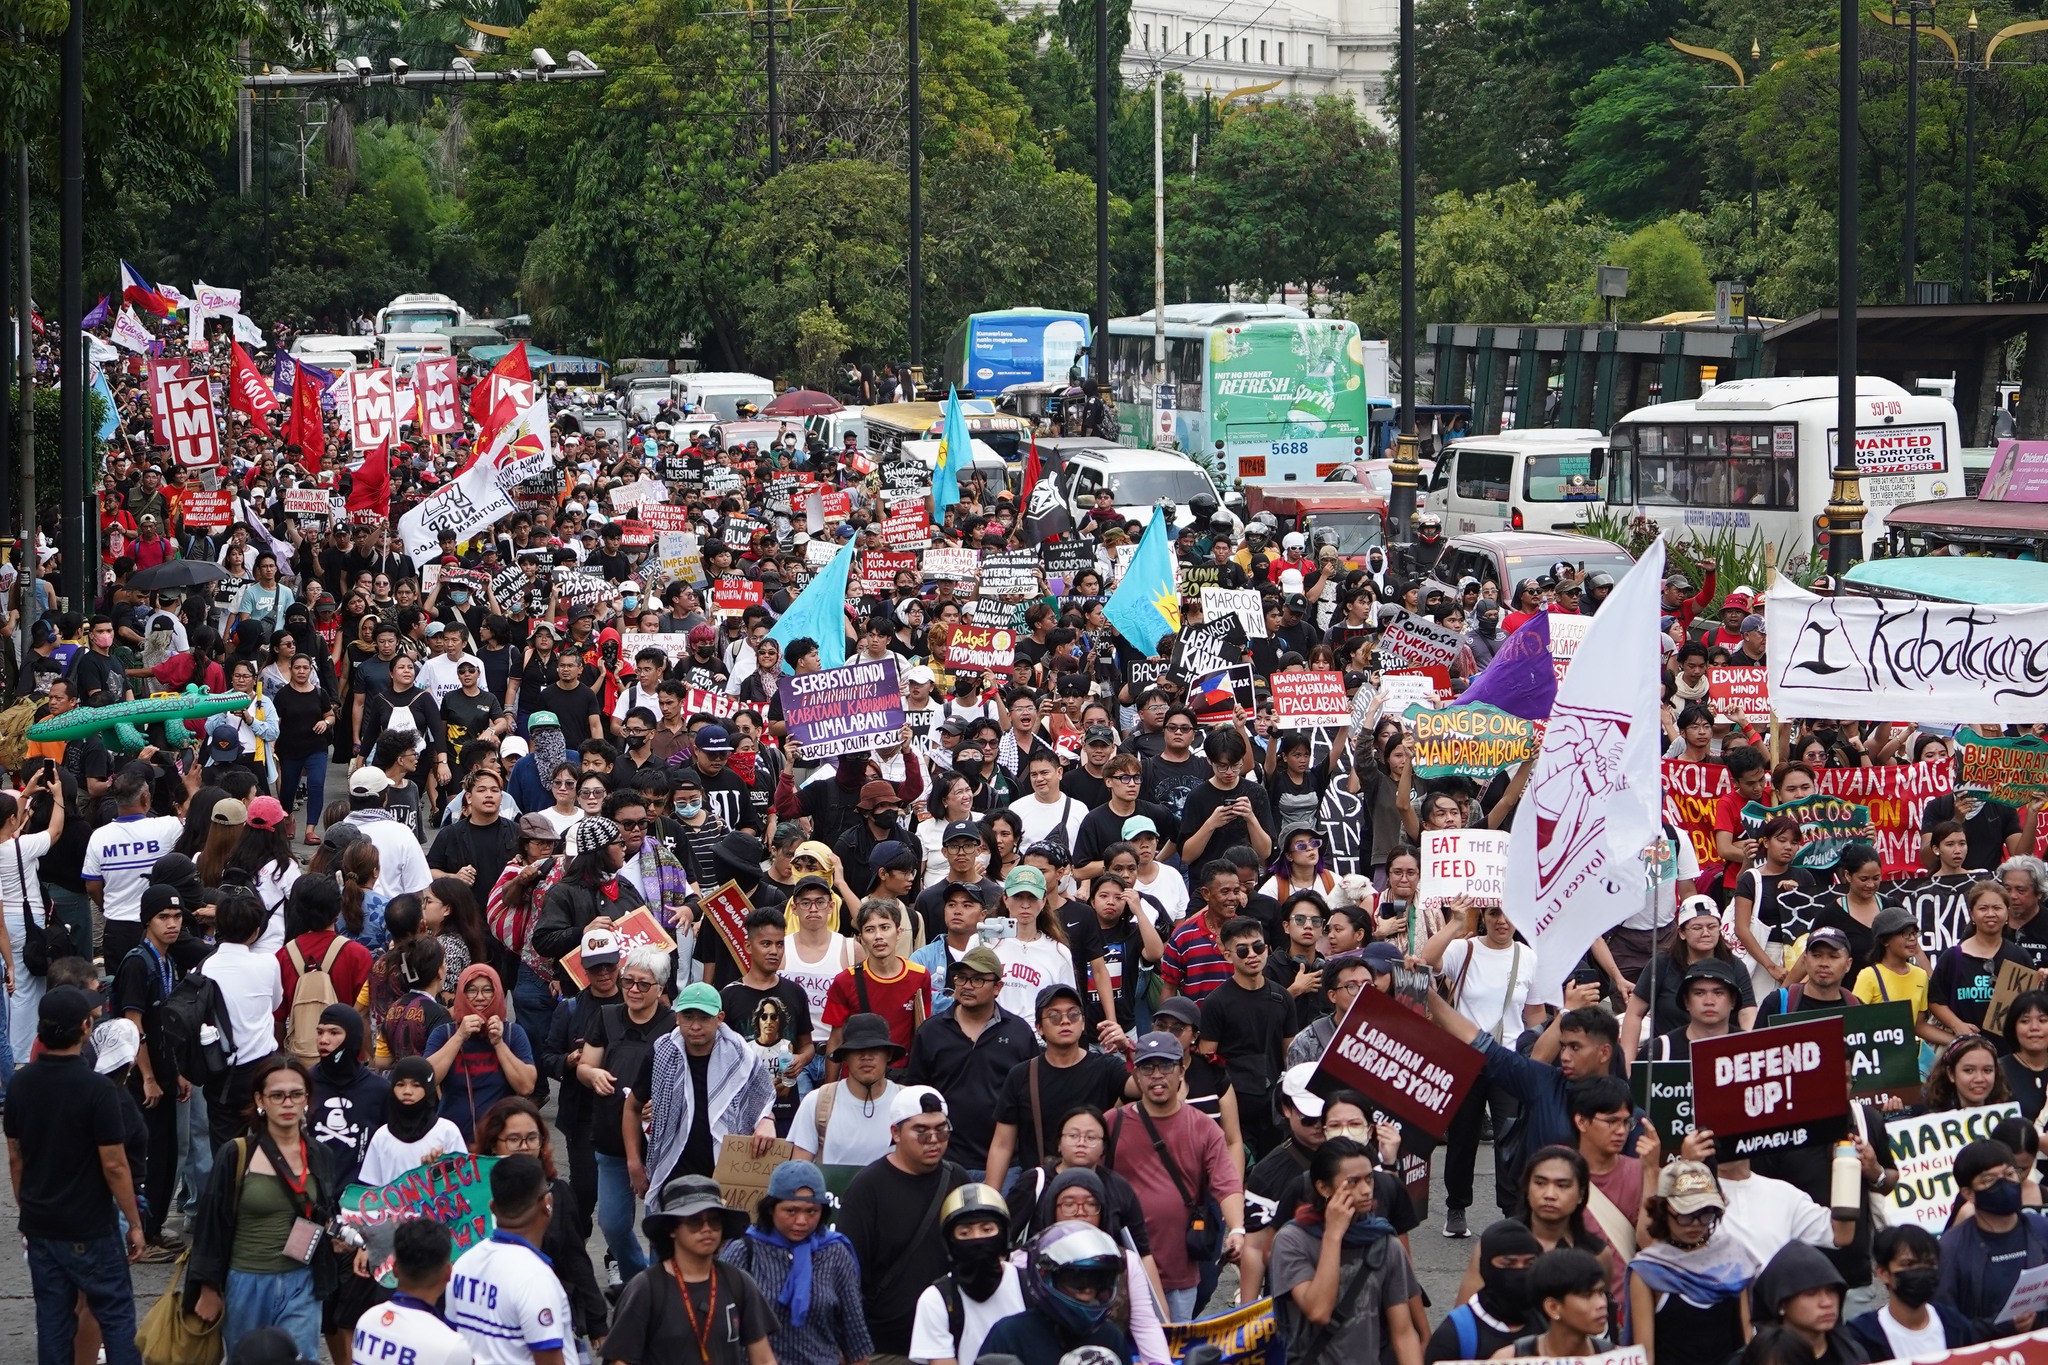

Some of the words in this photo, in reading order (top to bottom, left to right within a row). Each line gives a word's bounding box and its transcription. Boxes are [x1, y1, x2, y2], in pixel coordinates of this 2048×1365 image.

[1215, 371, 1231, 379] INIT
[1231, 371, 1243, 379] NG
[1243, 370, 1273, 379] BYAHE?
[1218, 377, 1291, 395] REFRESH
[426, 363, 455, 431] KMU
[1292, 384, 1335, 414] Sprite
[354, 371, 391, 445] KMU
[168, 379, 214, 465] KMU
[1272, 441, 1309, 455] 5688
[1855, 435, 1932, 450] WANTED
[1857, 449, 1875, 458] US
[1880, 447, 1931, 457] DRIVER
[1857, 454, 1936, 465] ONDUCTOR
[666, 457, 688, 468] FREE
[712, 466, 731, 475] STOP
[882, 462, 895, 472] NO
[912, 460, 923, 469] TO
[1239, 458, 1265, 474] TYP419
[1858, 462, 1934, 474] 23-377-0568
[883, 467, 928, 479] MANDATORY
[315, 491, 326, 501] NOT
[794, 494, 804, 503] NO
[286, 501, 327, 514] TERRORISTS!
[883, 527, 928, 544] LUMALABAN!
[662, 555, 699, 568] IMPEACH
[866, 551, 884, 559] MGA
[505, 562, 523, 581] NOW
[673, 566, 693, 577] SARA
[866, 559, 913, 569] KURAKOT,
[1048, 559, 1093, 571] KORAPSYON
[507, 573, 530, 592] WAGE
[1204, 592, 1261, 612] MARCOS
[627, 634, 657, 643] LOKAL
[951, 628, 991, 650] Budget
[1179, 626, 1224, 657] LABAN
[1385, 625, 1455, 662] EDUKASYON
[691, 666, 710, 678] MGA
[955, 669, 978, 678] UPLB
[1273, 673, 1321, 685] KARAPATAN
[1324, 673, 1337, 682] NG
[1712, 668, 1768, 685] EDUKASY
[1230, 677, 1250, 689] TAX
[1276, 685, 1295, 694] MGA
[1295, 683, 1345, 696] KABATAAN,
[1730, 684, 1759, 695] HINDI
[1710, 696, 1772, 714] MILITARISAS
[808, 711, 888, 741] LUMALABAN!
[800, 743, 840, 759] ABRIELA
[1415, 736, 1531, 767] MANDARAMBONG
[1963, 744, 2048, 770] BURUKRAT
[1963, 765, 2048, 786] KAPITALISM
[103, 839, 161, 858] MTPB
[1432, 836, 1461, 854] EAT
[1468, 840, 1493, 853] THE
[1432, 860, 1476, 878] FEED
[1486, 865, 1507, 878] TH
[1000, 961, 1042, 987] L-QUDS
[1873, 1028, 1905, 1046] ang
[1356, 1021, 1423, 1074] LABANAN
[1426, 1062, 1455, 1091] ANG
[1715, 1041, 1821, 1087] DEFEND
[1337, 1033, 1454, 1115] KORAPSYON!
[1651, 1083, 1692, 1098] Kont
[1744, 1075, 1794, 1118] UP!
[1735, 1128, 1808, 1154] AUPAEU-LB
[1902, 1155, 1955, 1177] SINGIL
[359, 1154, 482, 1226] CONVICT
[354, 1328, 418, 1365] MTPB
